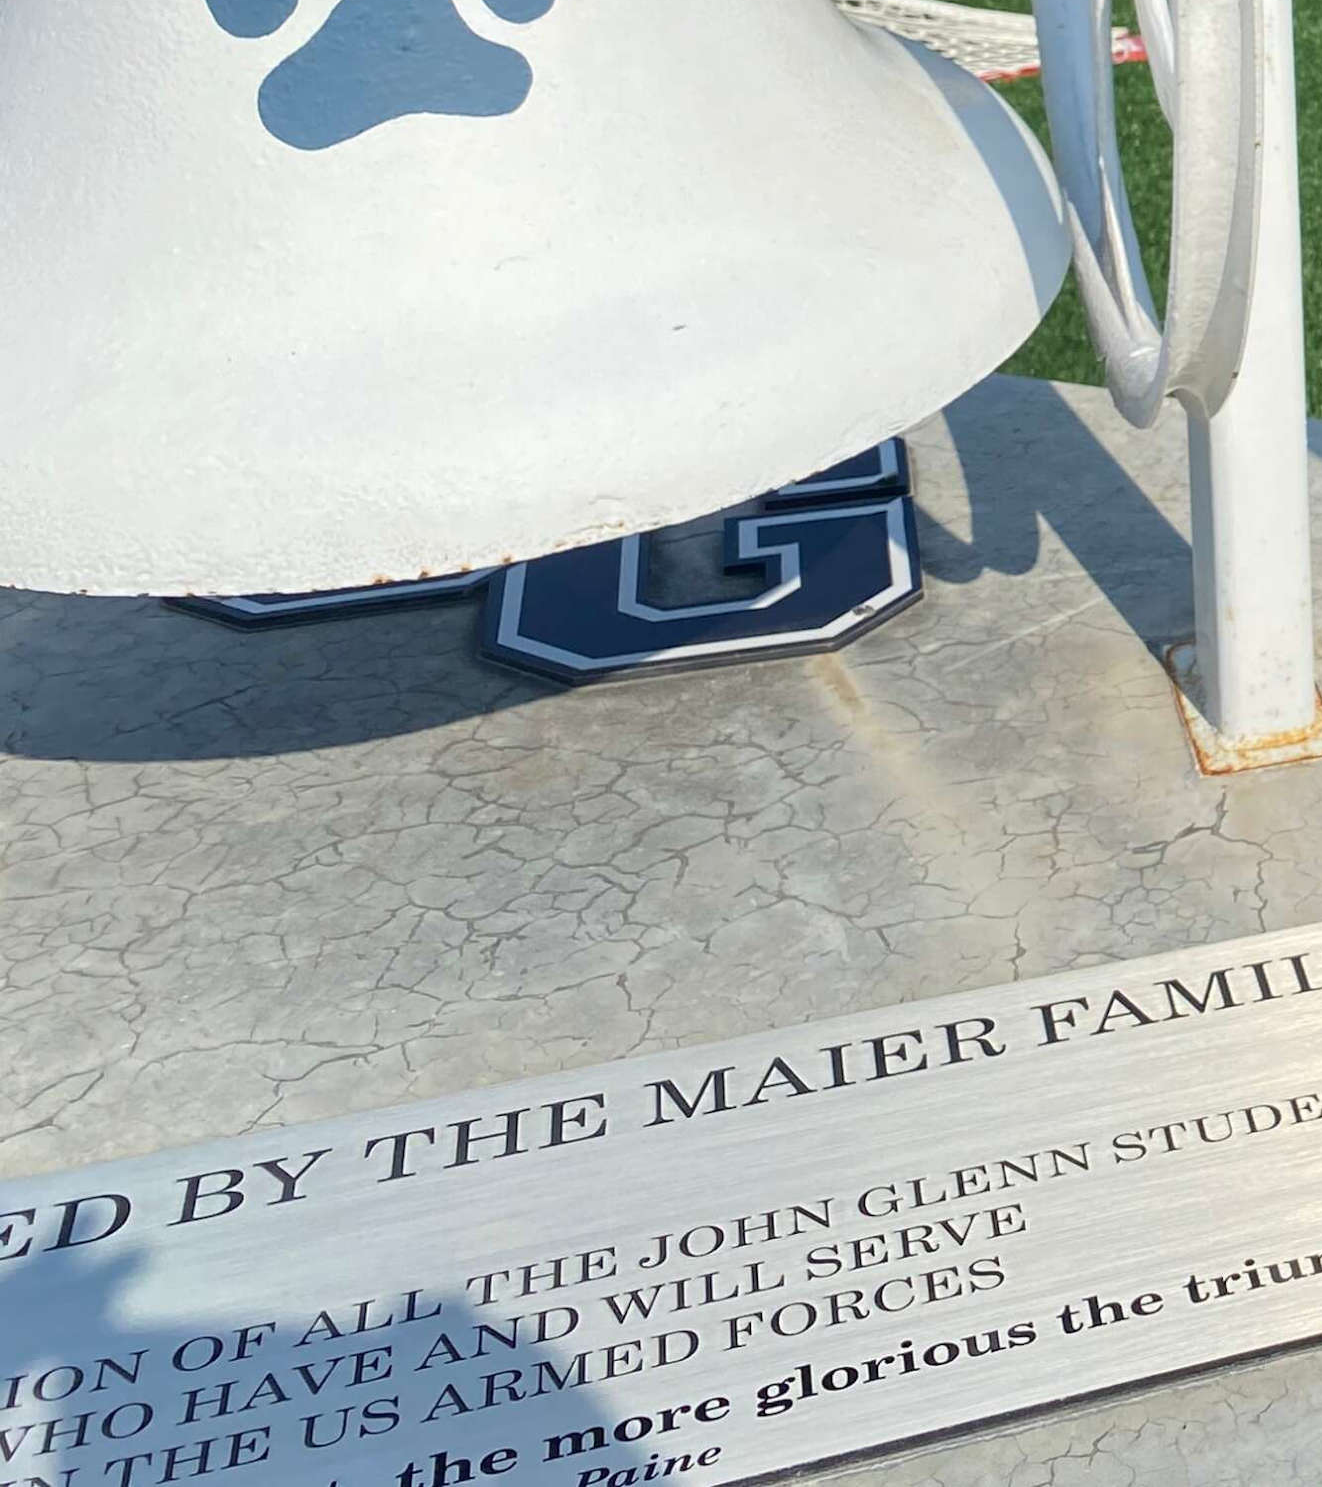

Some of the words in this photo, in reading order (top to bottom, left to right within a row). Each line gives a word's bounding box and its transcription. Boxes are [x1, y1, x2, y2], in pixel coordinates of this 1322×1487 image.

[167, 1149, 332, 1227] BY
[364, 1093, 608, 1183] THE
[642, 1017, 1006, 1128] MAIER
[172, 1321, 276, 1372] OF
[293, 1289, 442, 1347] ALL
[468, 1247, 619, 1305] THE
[638, 1199, 832, 1270] JOHN
[858, 1143, 1091, 1219] GLENN
[176, 1345, 393, 1426] HAVE
[414, 1305, 580, 1371] AND
[604, 1261, 785, 1325] WILL
[806, 1203, 1028, 1281] SERVE
[103, 1425, 271, 1487] THE
[299, 1395, 401, 1449] US
[421, 1328, 700, 1424] ARMED
[727, 1256, 1006, 1351] FORCES
[394, 1448, 518, 1487] the
[542, 1394, 730, 1462] more
[755, 1322, 1036, 1417] glorious
[1056, 1289, 1163, 1338] the
[576, 1445, 724, 1487] Paine
